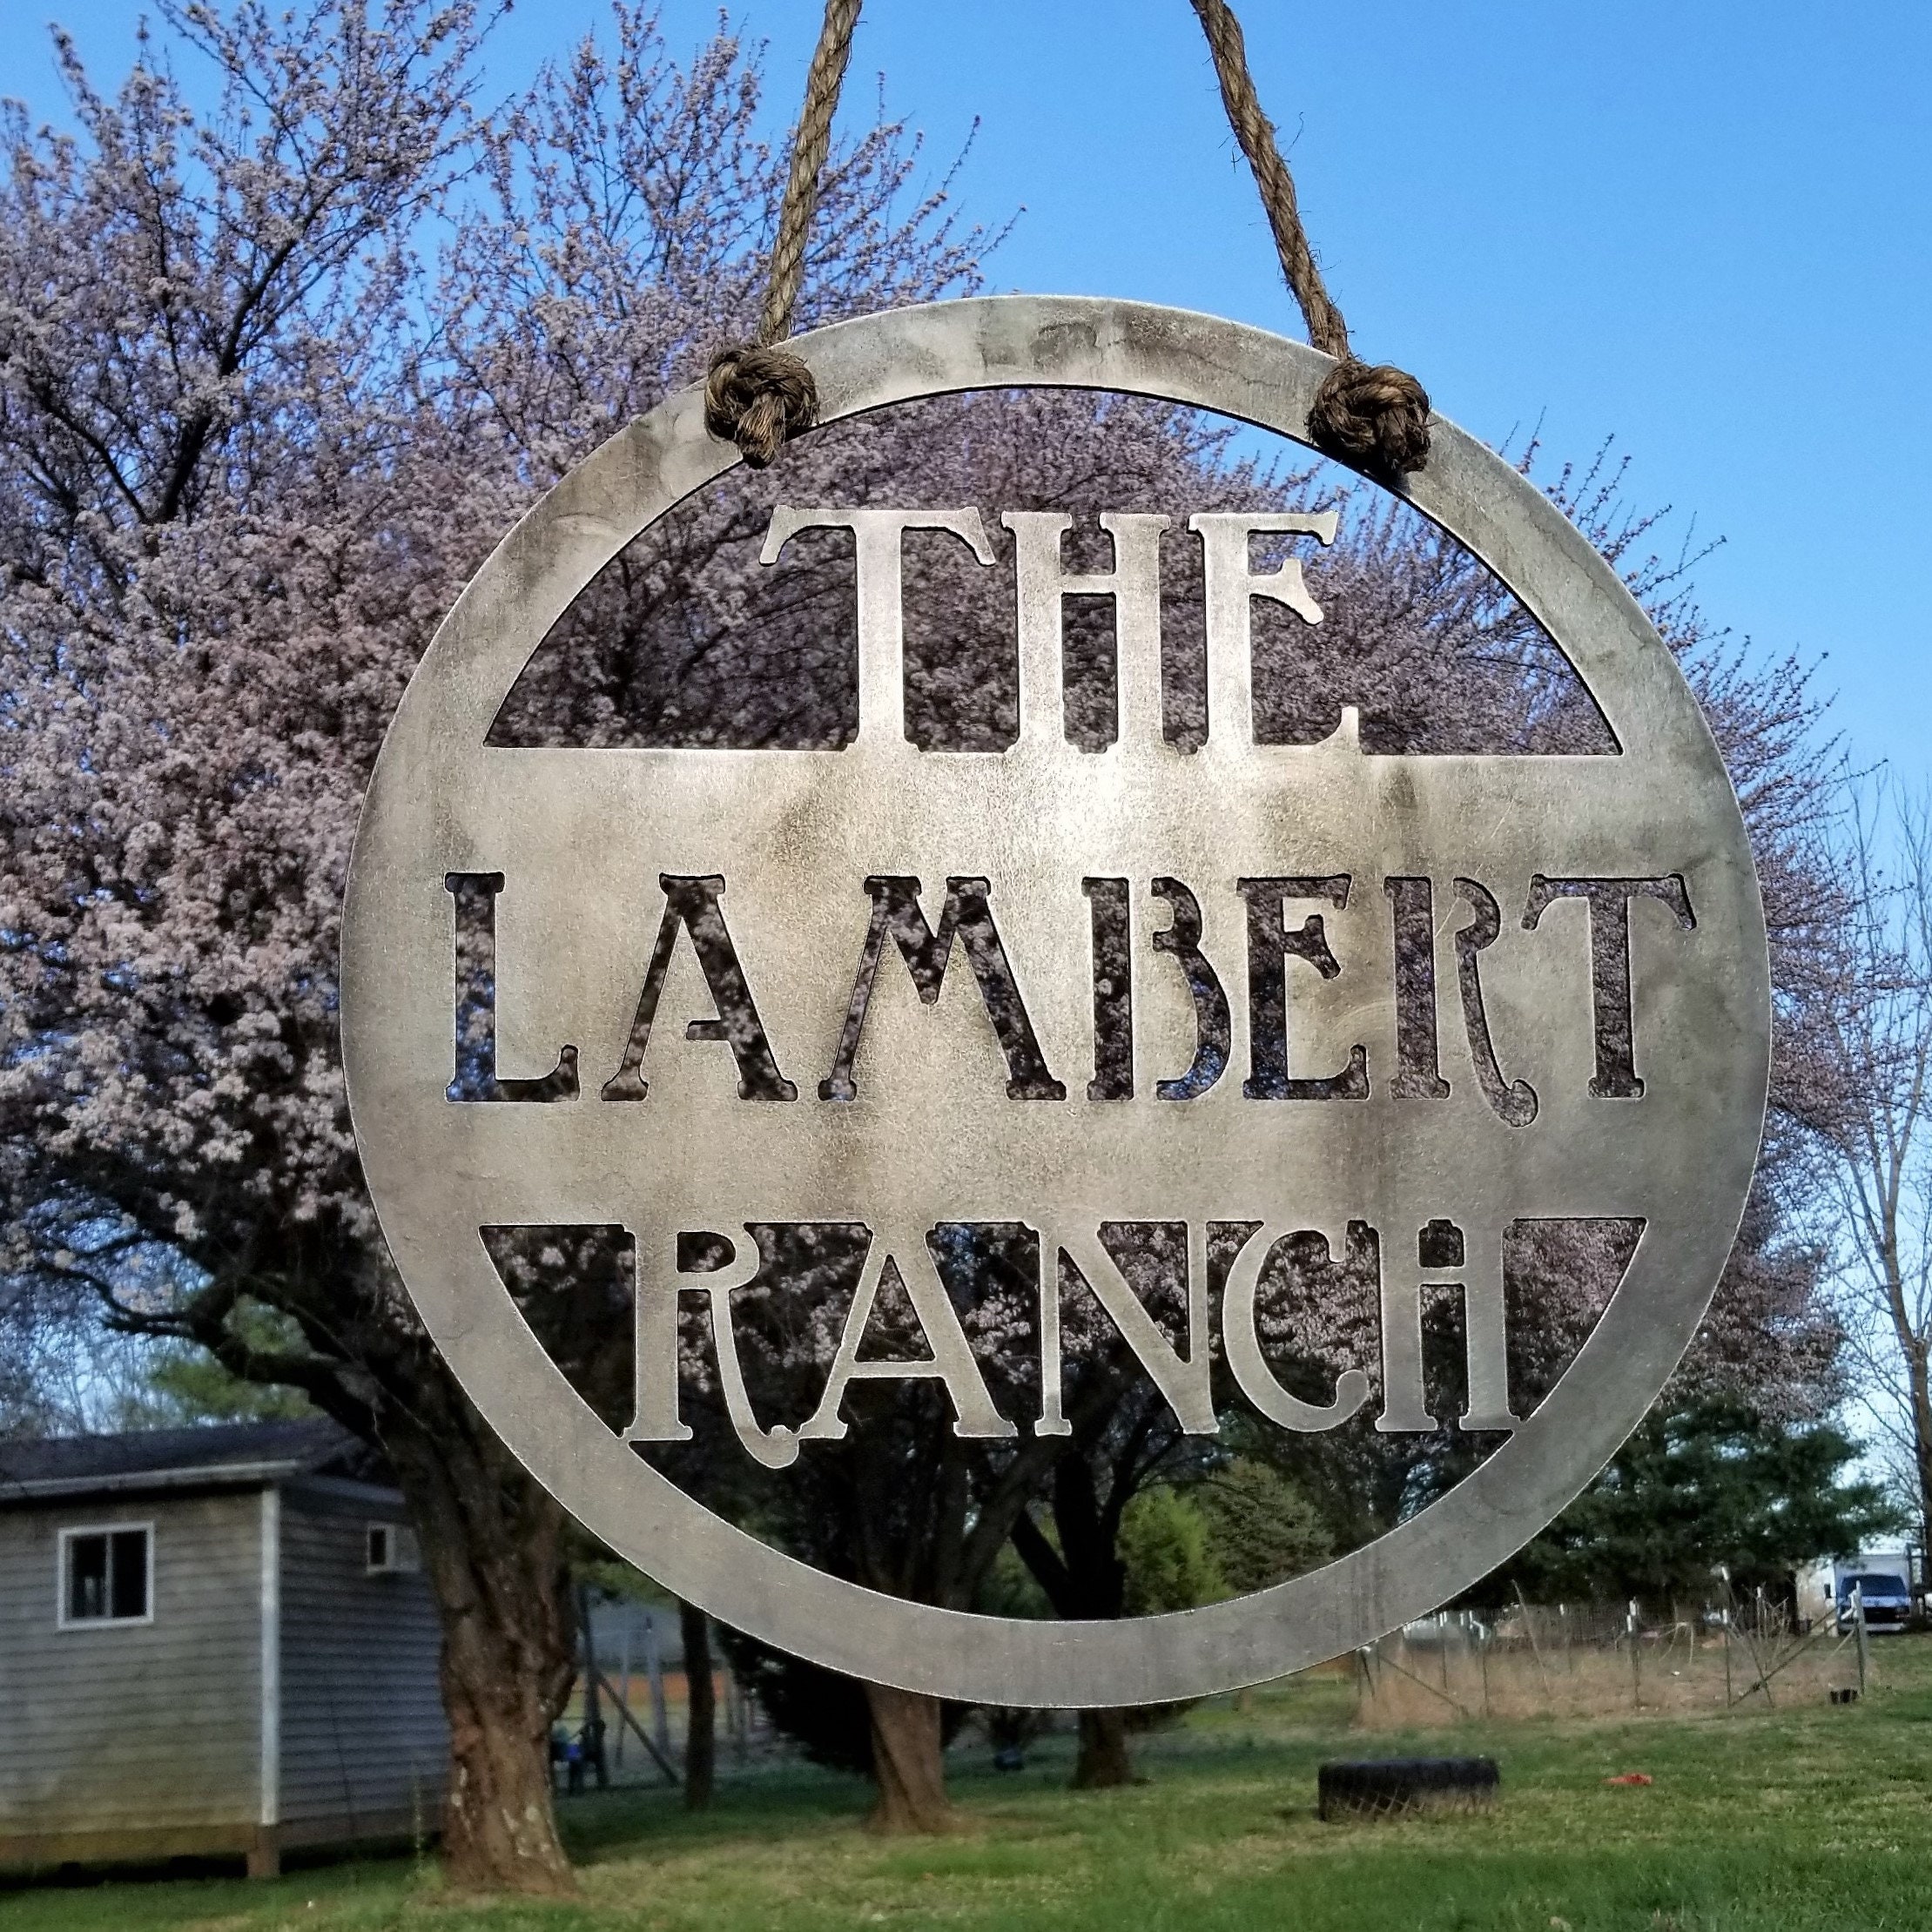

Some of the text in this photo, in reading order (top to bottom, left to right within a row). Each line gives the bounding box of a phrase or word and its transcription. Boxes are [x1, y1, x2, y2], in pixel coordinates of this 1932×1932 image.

[758, 505, 1361, 754] THE
[444, 872, 1698, 1127] LAMBERT
[615, 1217, 1522, 1469] RANCH
